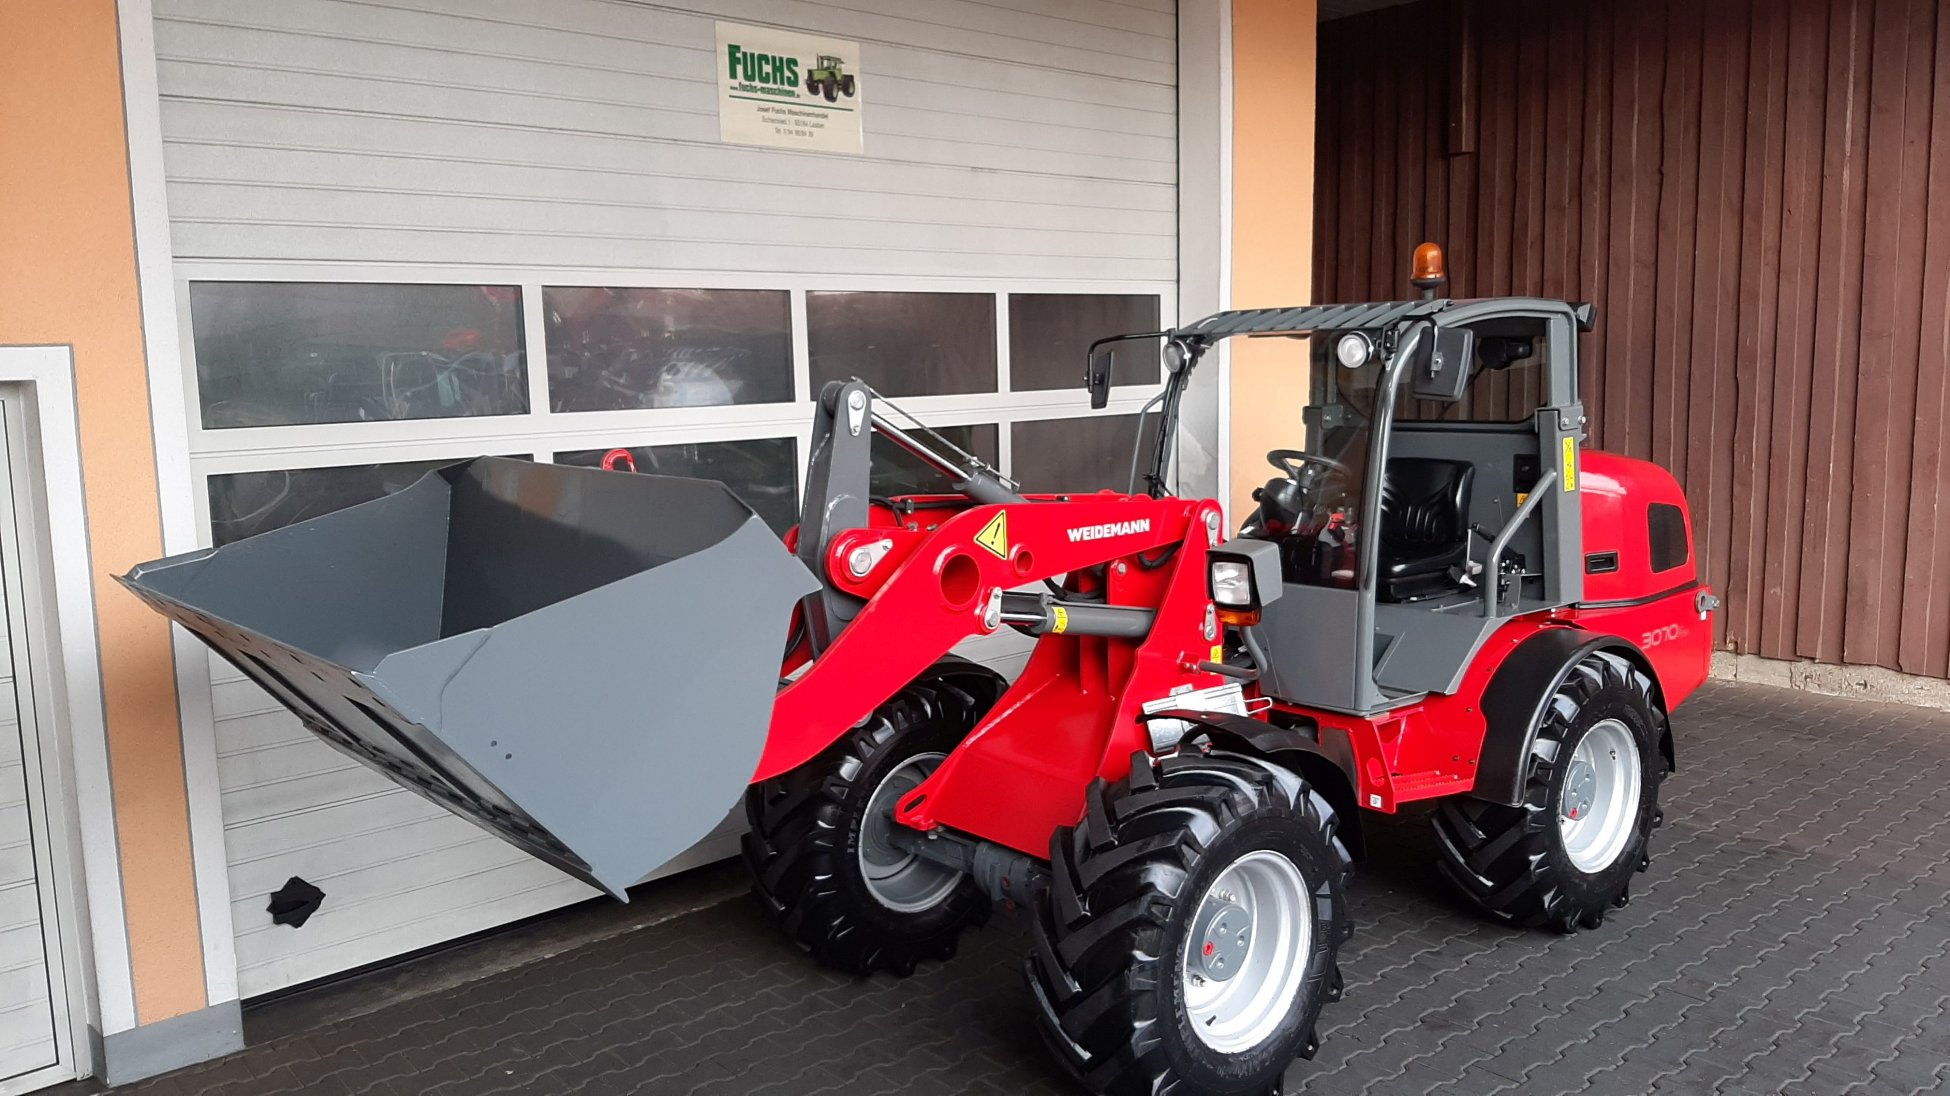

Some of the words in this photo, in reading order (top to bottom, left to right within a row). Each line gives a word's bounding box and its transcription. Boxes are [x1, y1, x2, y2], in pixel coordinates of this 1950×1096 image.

[728, 44, 799, 87] FUCHS
[1067, 518, 1150, 542] WEIDEMANN
[1641, 623, 1679, 650] 3070
